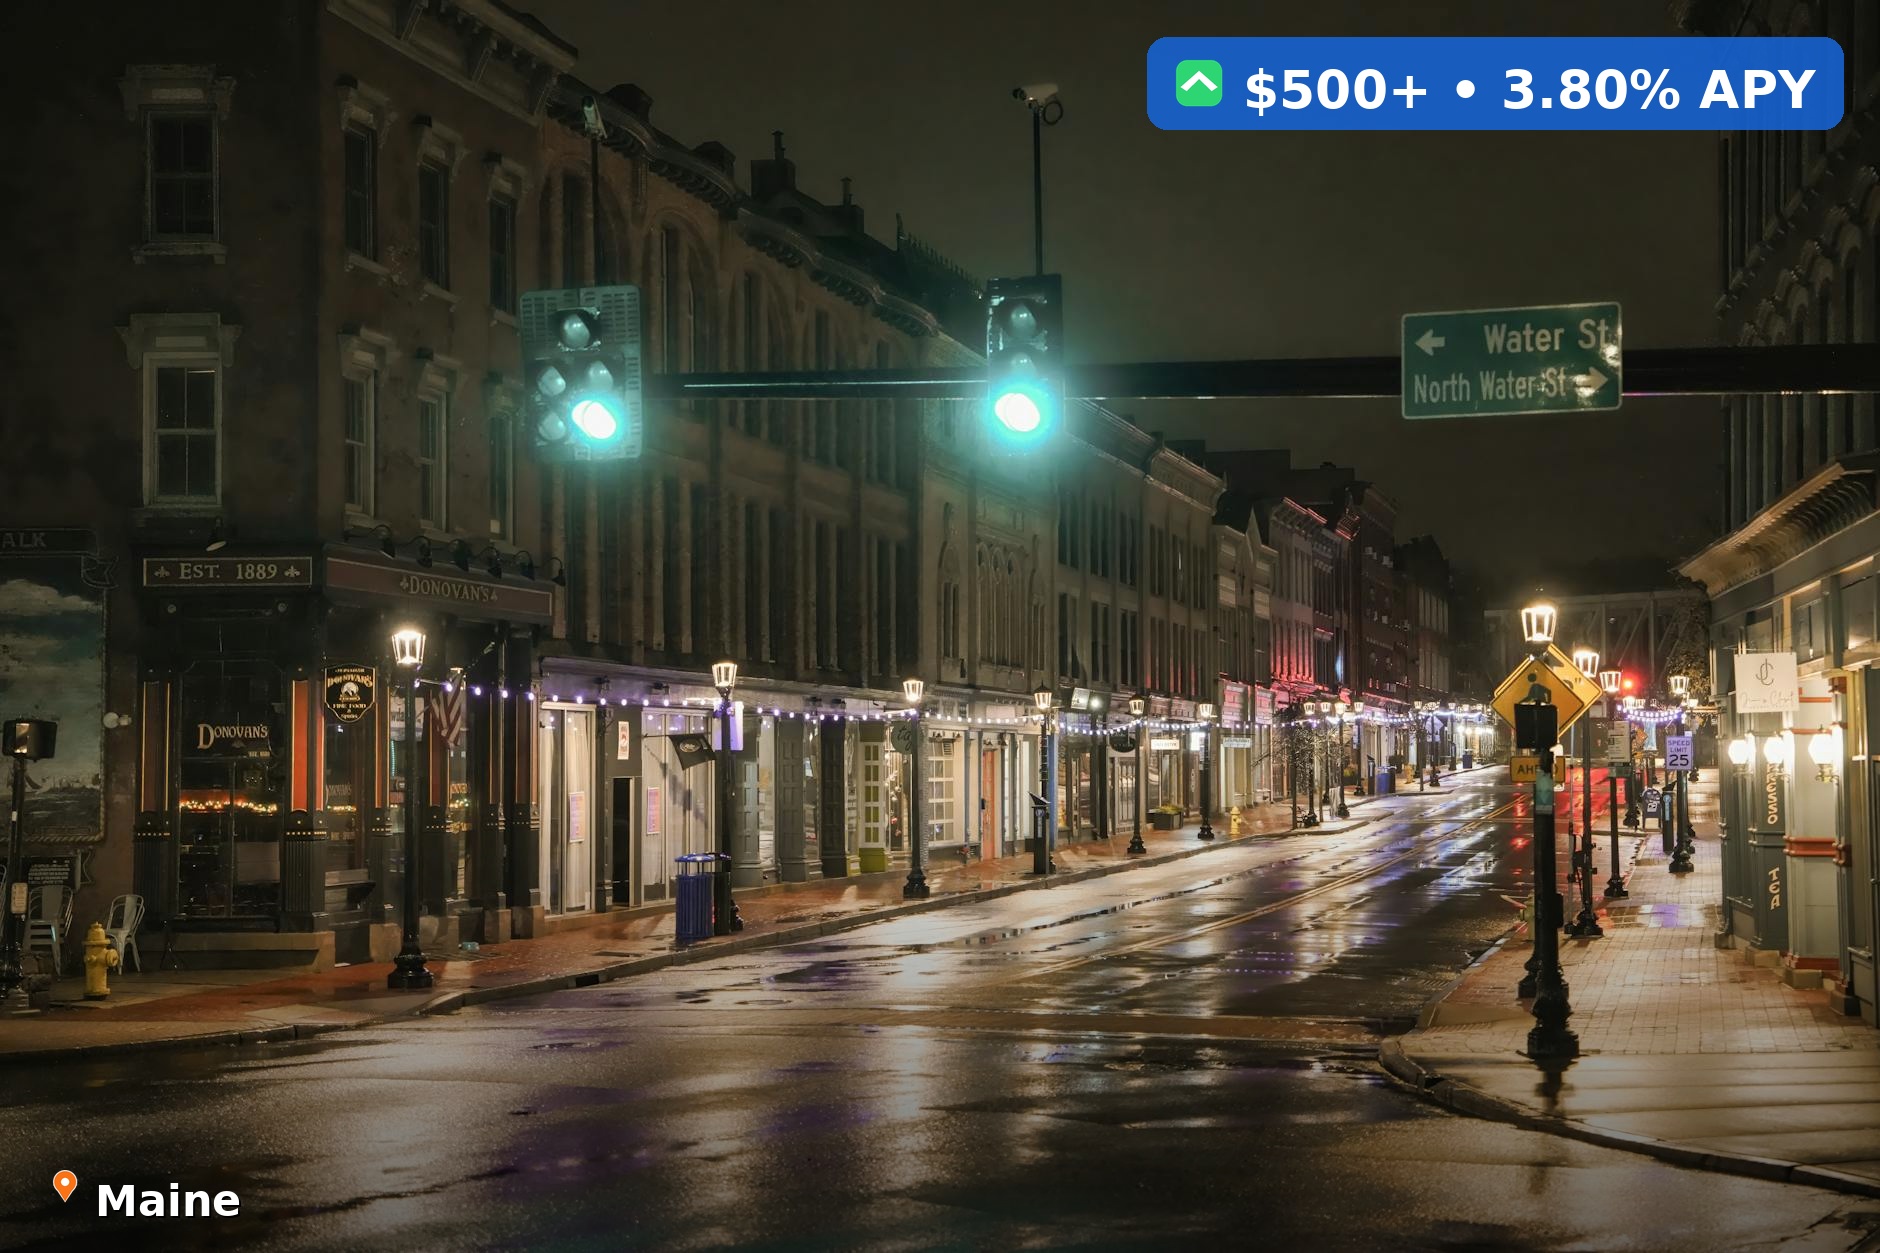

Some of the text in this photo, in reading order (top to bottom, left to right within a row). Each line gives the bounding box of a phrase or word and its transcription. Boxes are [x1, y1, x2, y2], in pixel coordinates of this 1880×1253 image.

[1483, 318, 1609, 355] Water St
[1414, 366, 1567, 404] North Water St
[178, 562, 278, 580] EST. 1889
[409, 575, 489, 602] DONOVAN'S
[1669, 754, 1689, 766] 25
[1768, 867, 1781, 911] TEA
